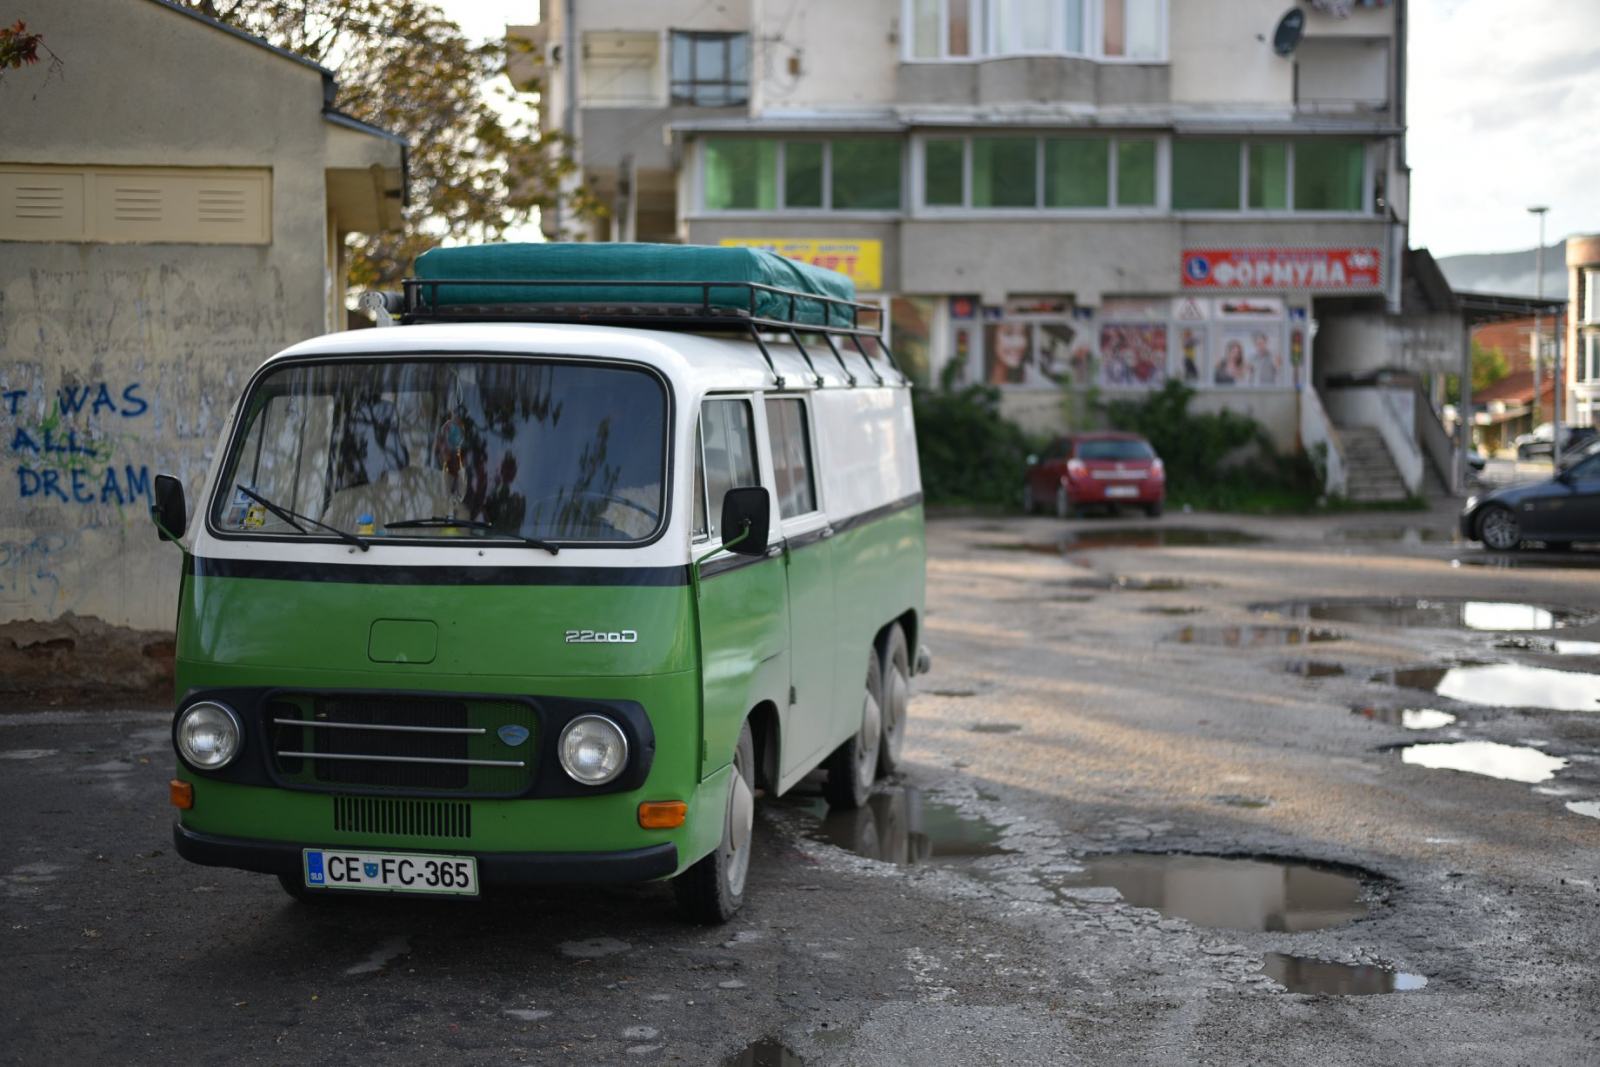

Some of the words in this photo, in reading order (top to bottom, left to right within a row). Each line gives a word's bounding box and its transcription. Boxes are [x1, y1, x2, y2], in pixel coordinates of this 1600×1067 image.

[56, 382, 147, 417] WAS
[11, 427, 97, 456] ALL
[565, 629, 638, 643] 2200D
[328, 856, 361, 883] CE
[381, 858, 469, 888] FC-365
